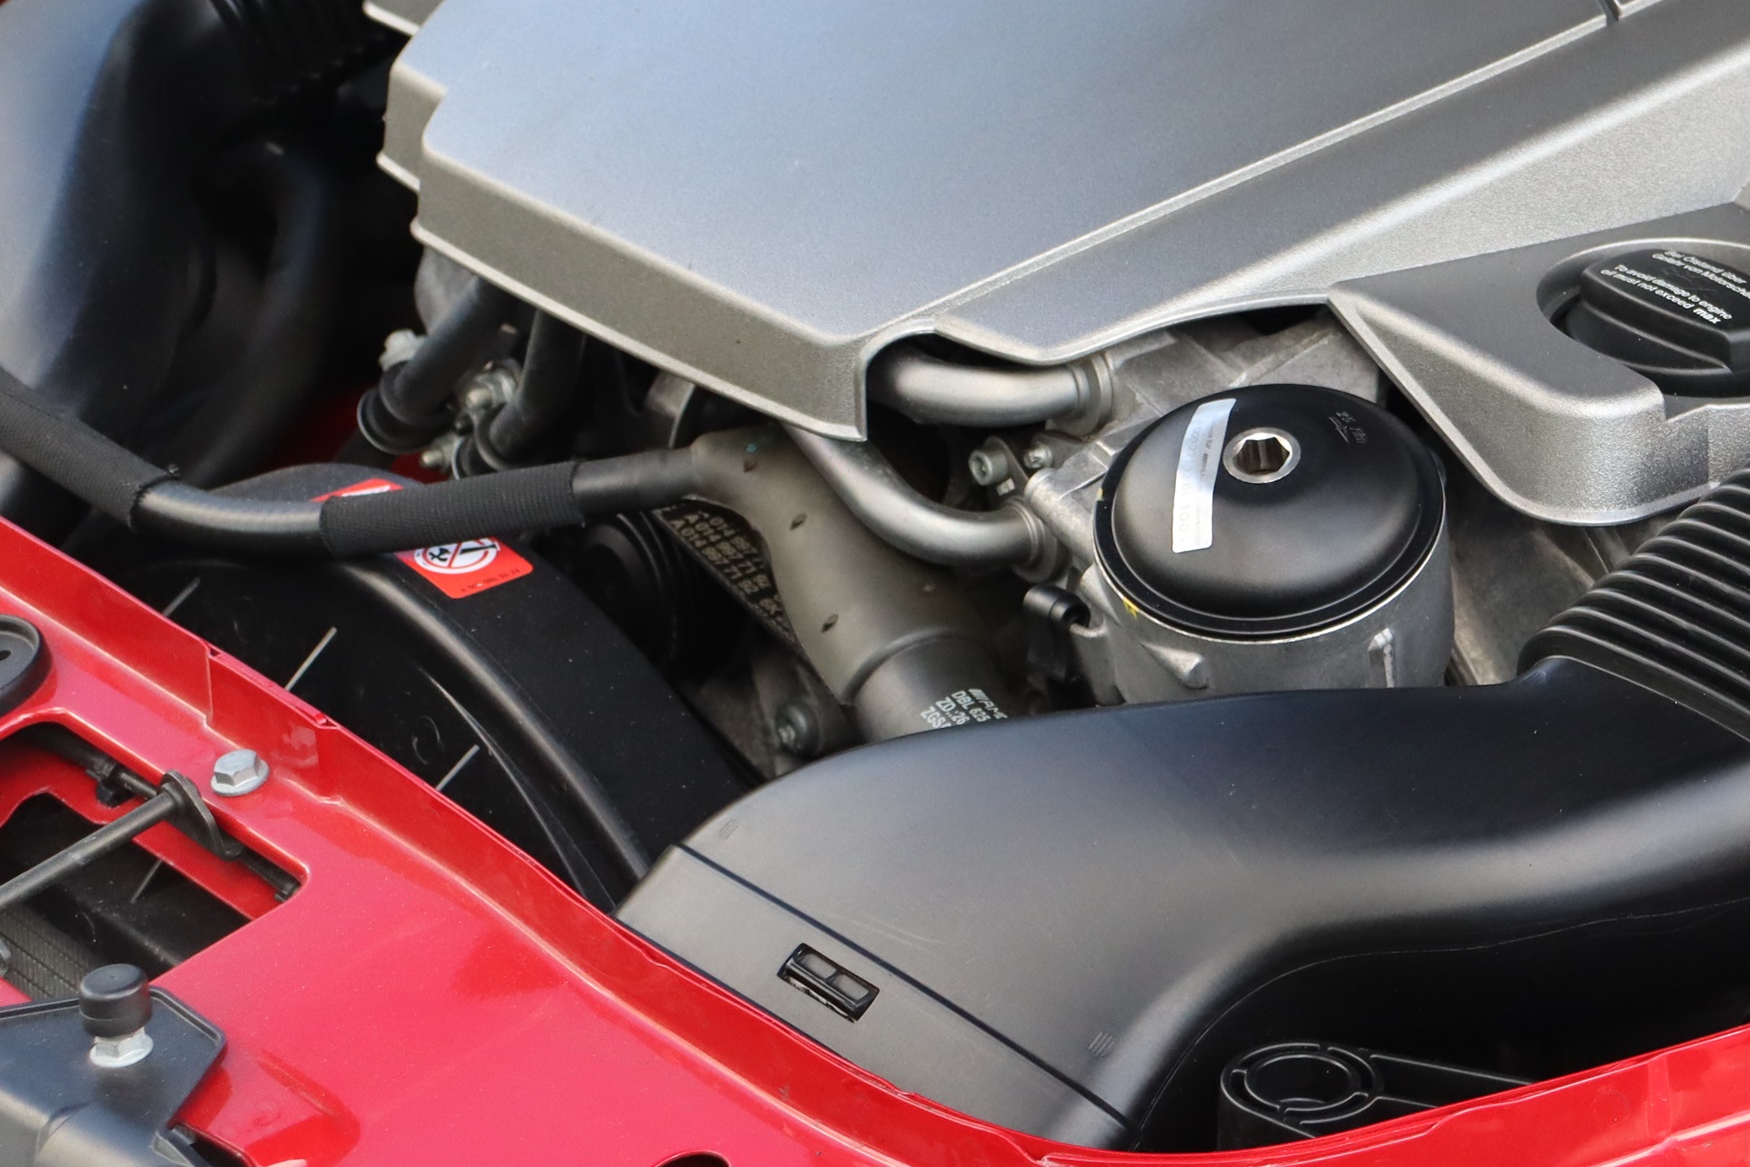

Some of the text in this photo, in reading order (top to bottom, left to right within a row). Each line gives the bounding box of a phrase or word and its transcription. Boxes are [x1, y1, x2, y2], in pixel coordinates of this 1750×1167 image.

[1613, 274, 1640, 285] must
[1637, 282, 1658, 291] not
[1655, 290, 1695, 309] exceed
[1693, 308, 1721, 324] max
[1614, 264, 1732, 319] To avoid damage to engine
[951, 690, 992, 723] DBL 625
